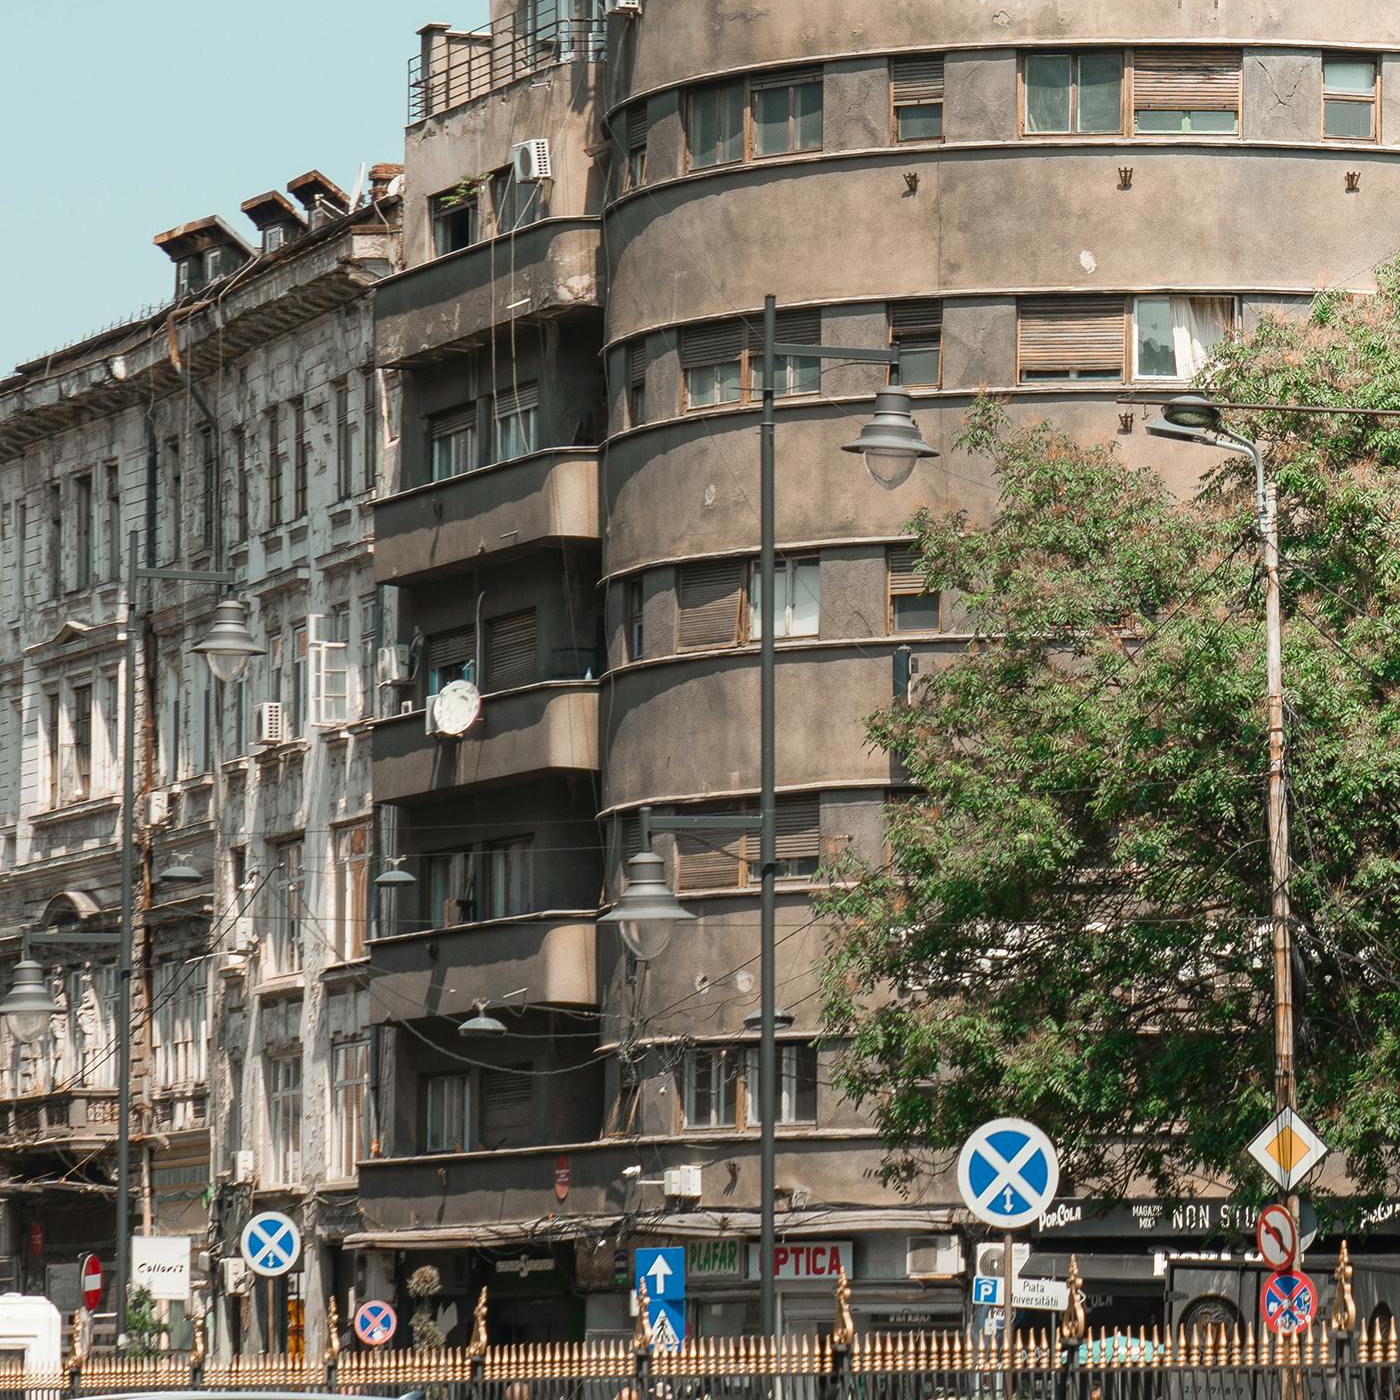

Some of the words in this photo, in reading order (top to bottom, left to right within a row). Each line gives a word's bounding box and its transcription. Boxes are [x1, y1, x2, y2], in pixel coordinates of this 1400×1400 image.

[1172, 1204, 1210, 1229] NON
[688, 1241, 737, 1273] PLAFAR
[759, 1245, 842, 1276] PTICA
